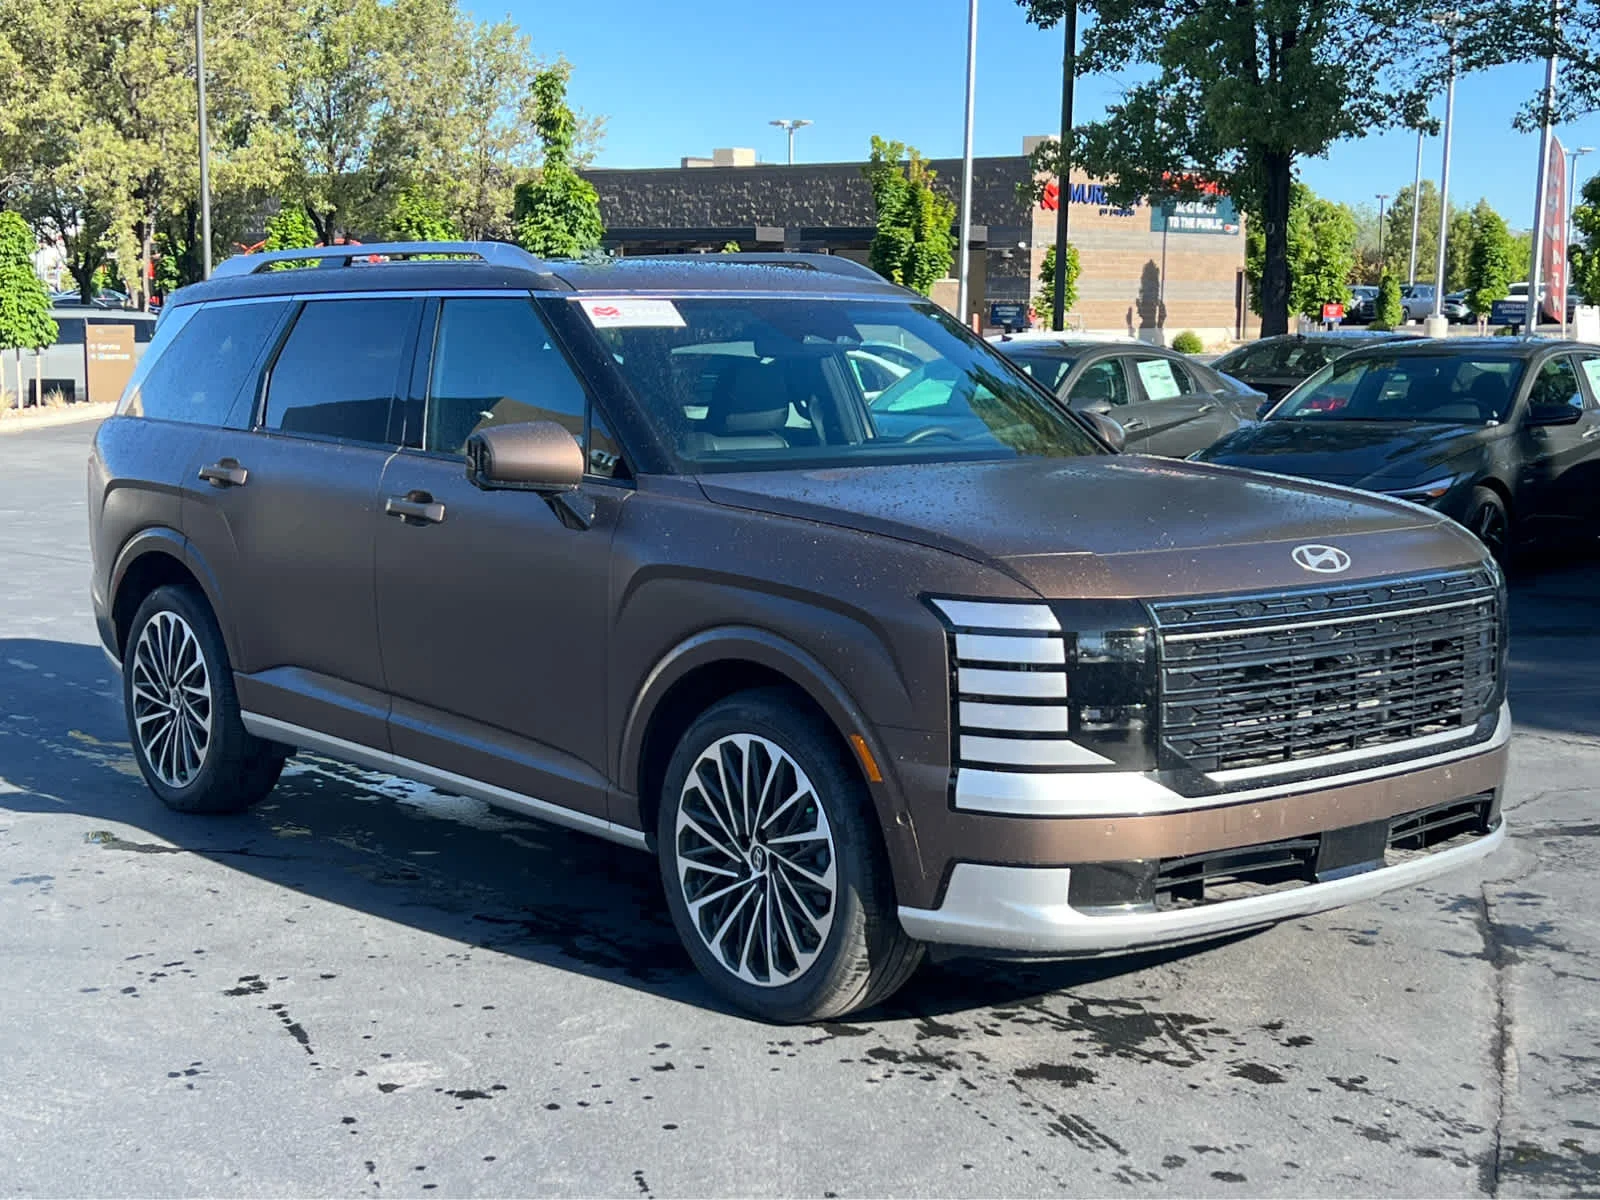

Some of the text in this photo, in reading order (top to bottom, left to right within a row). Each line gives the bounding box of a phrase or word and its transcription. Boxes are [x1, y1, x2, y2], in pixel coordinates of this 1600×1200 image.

[1168, 216, 1179, 228] TO
[1180, 217, 1195, 229] THE
[1196, 218, 1223, 230] PUBLIC
